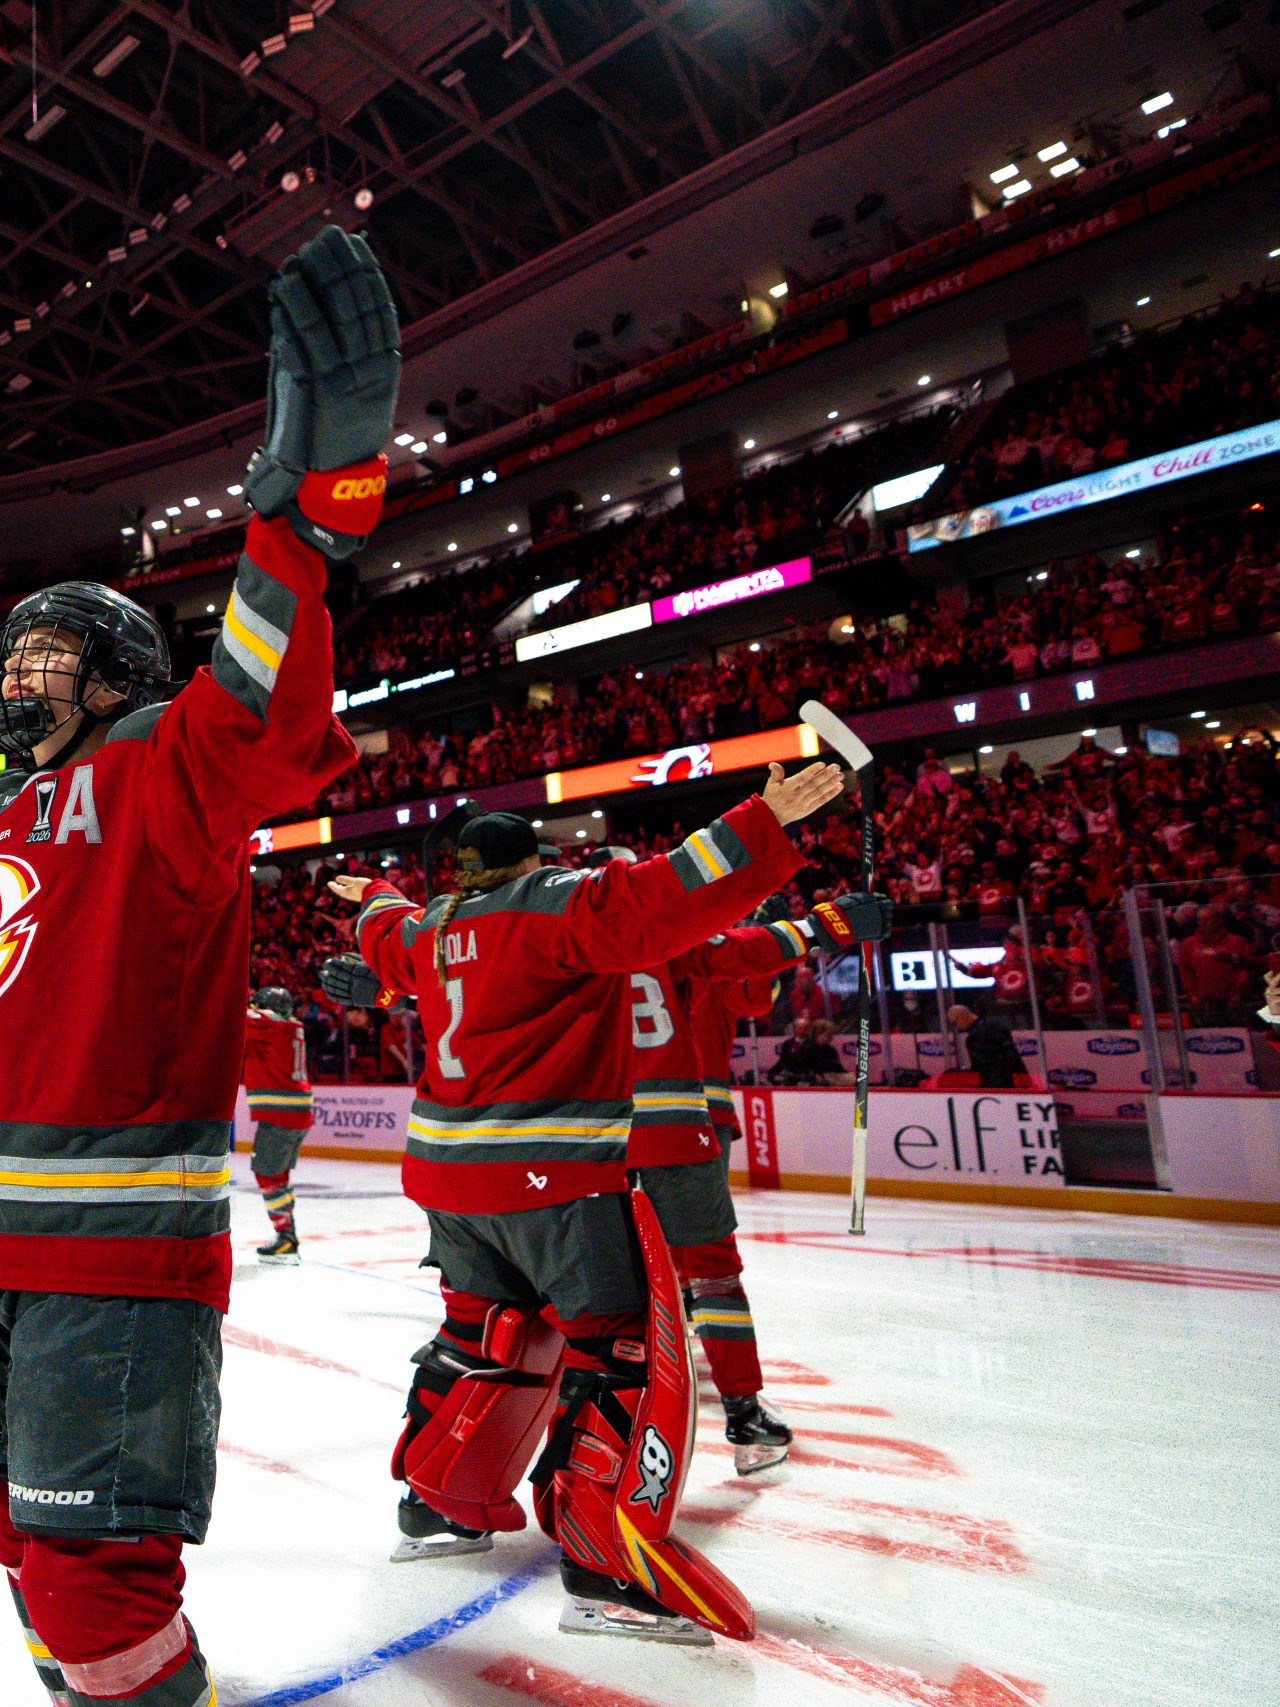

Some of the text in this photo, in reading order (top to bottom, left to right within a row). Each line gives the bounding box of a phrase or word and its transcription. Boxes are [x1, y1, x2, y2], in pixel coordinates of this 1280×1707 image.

[1153, 446, 1214, 478] Chill
[54, 763, 103, 845] A
[26, 830, 51, 843] 2026
[437, 976, 467, 1080] 1
[313, 1105, 397, 1130] PLAYOFFS
[750, 1096, 770, 1168] CCM
